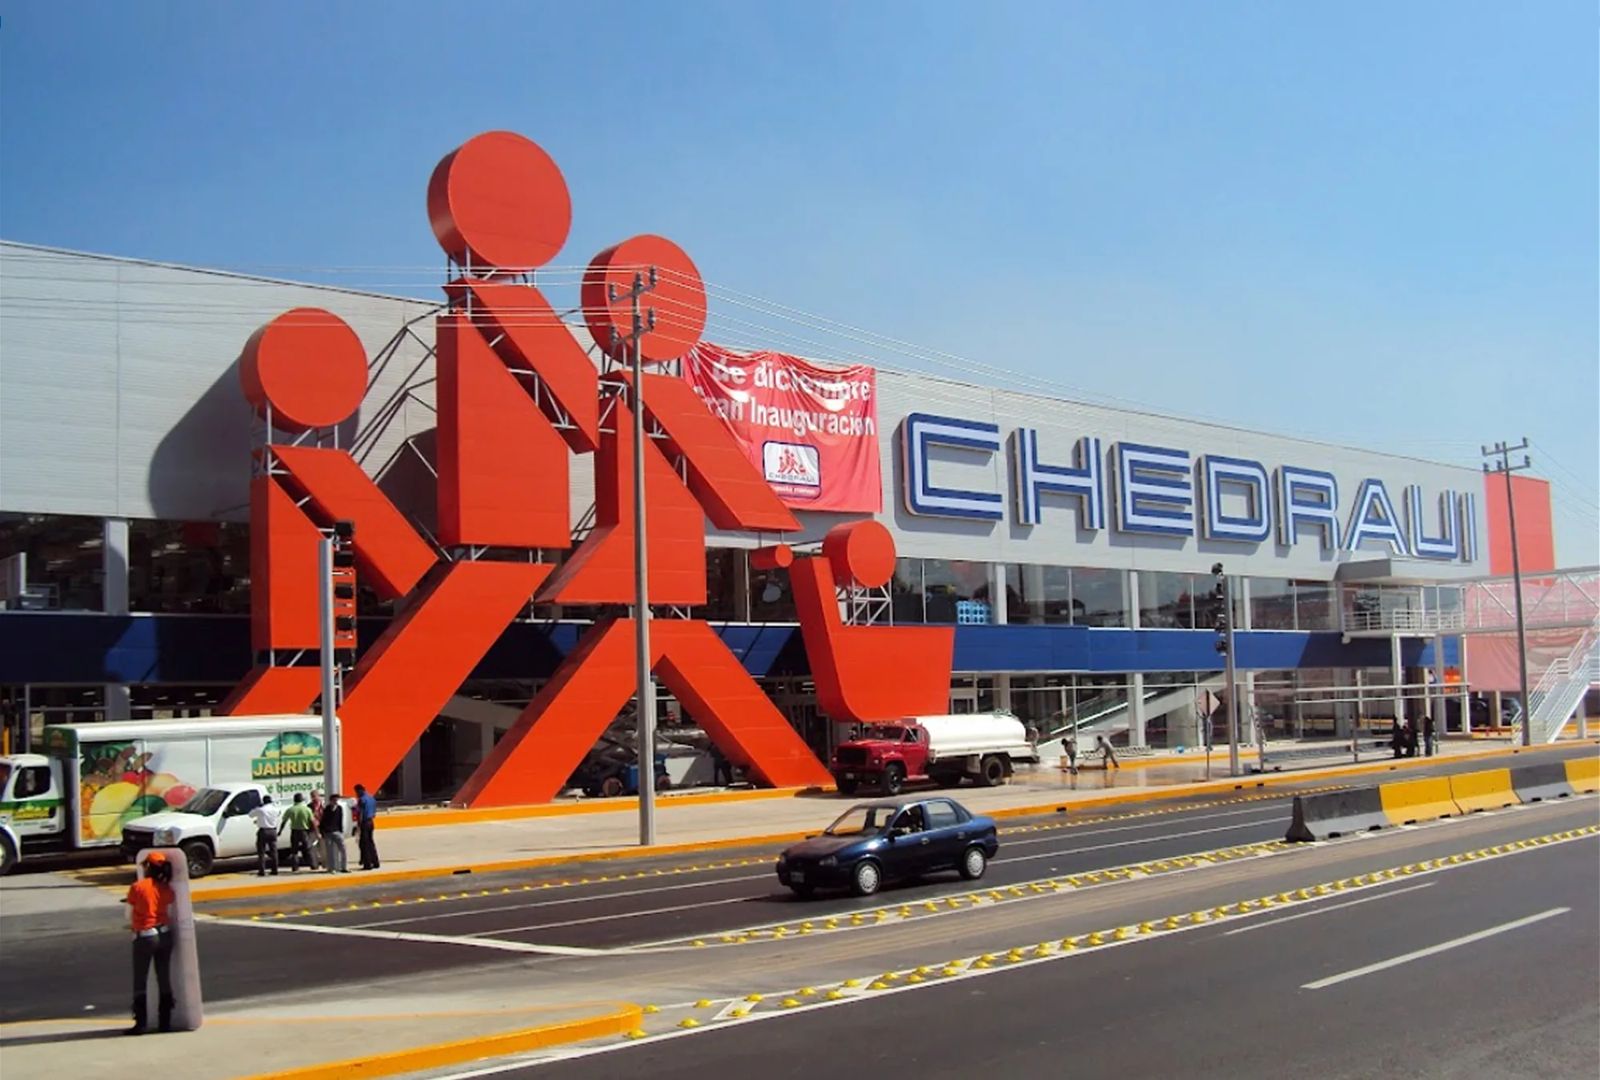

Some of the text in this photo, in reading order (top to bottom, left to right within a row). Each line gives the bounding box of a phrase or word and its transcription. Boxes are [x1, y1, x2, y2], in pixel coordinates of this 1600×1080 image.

[751, 396, 875, 437] Inauguración
[902, 412, 1478, 562] CHEDRAUI
[254, 760, 326, 776] JARRITO
